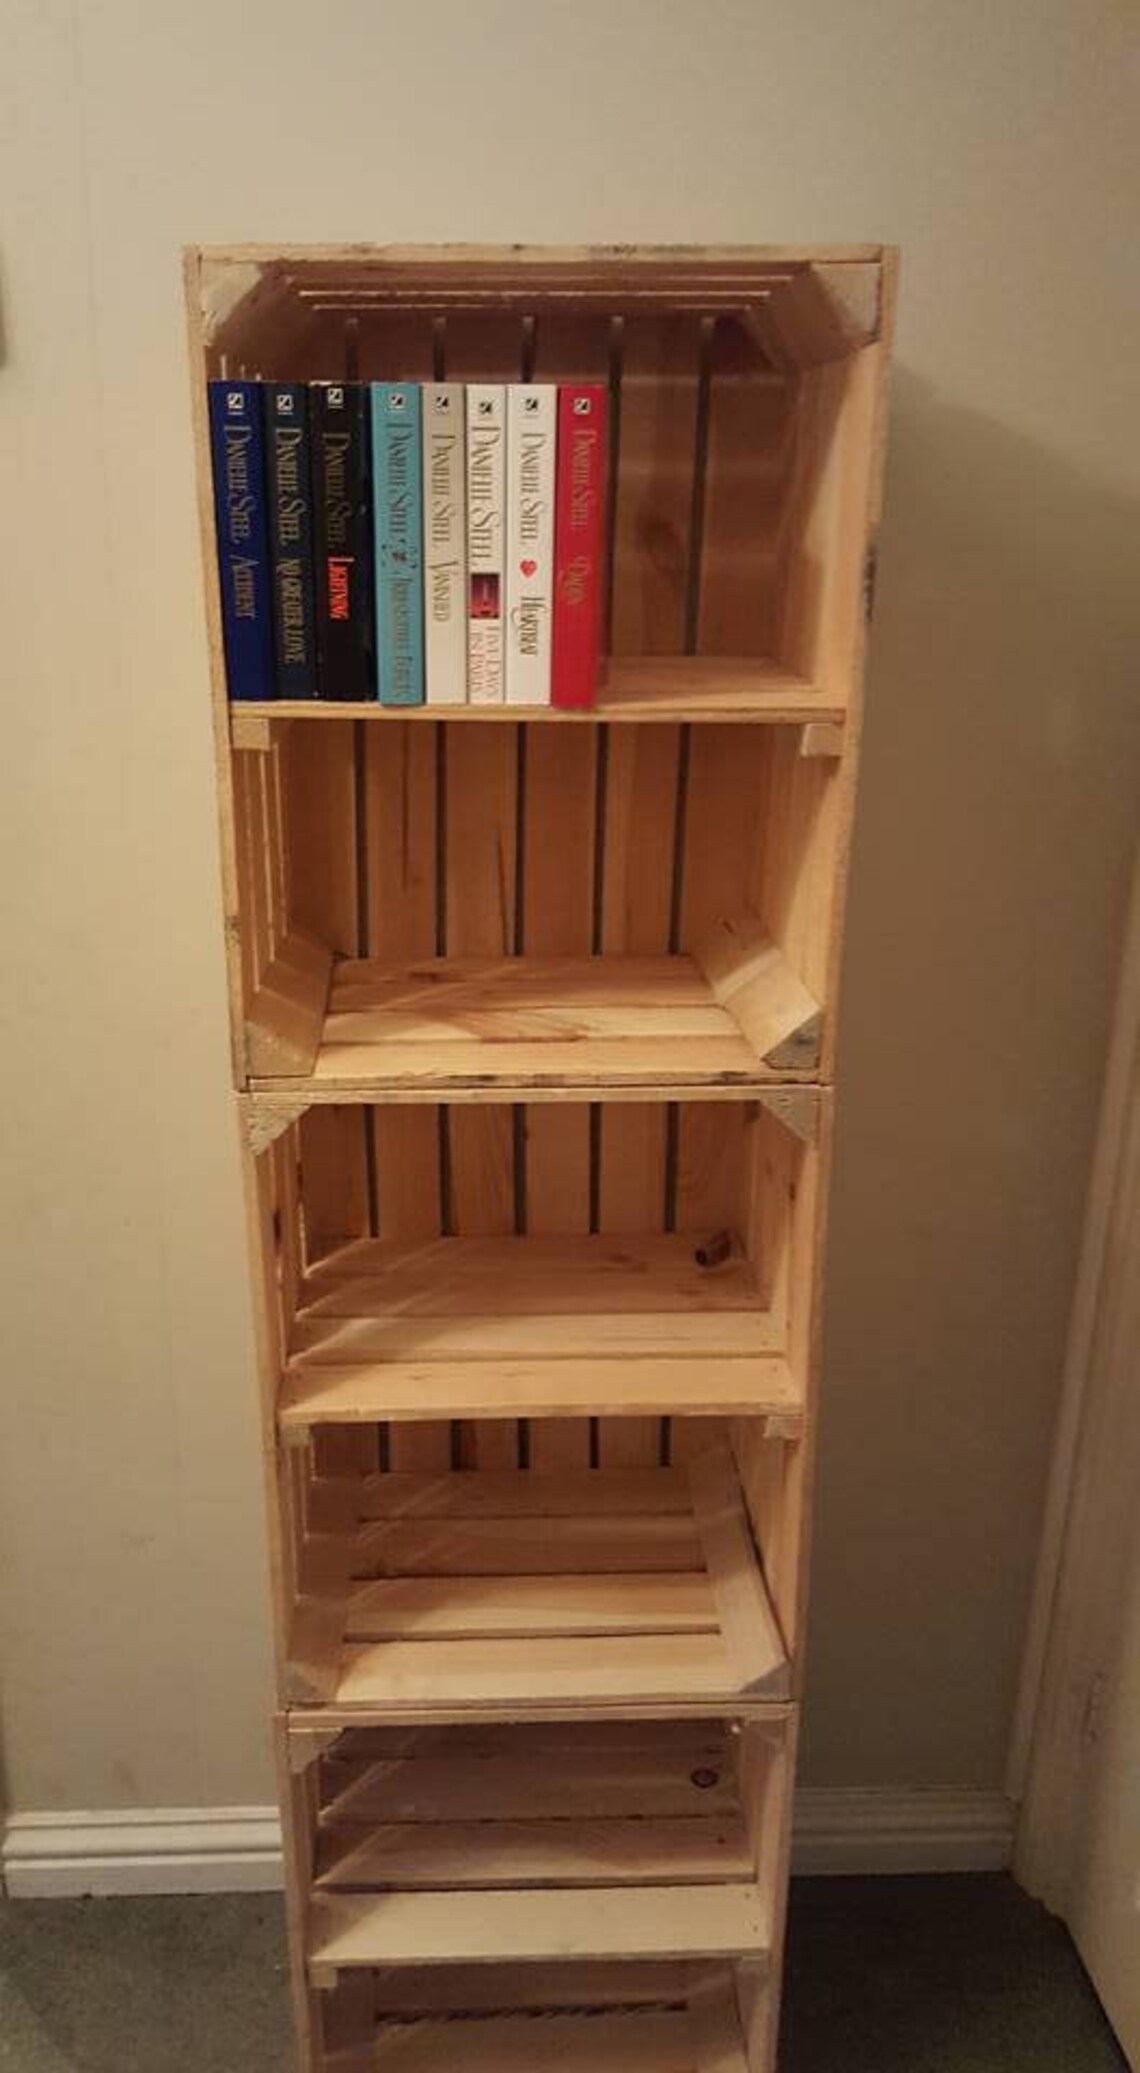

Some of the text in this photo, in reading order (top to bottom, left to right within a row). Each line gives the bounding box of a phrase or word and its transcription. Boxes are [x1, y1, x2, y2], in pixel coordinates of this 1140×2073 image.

[224, 425, 252, 493] DANIELLE
[276, 428, 302, 495] DANIELLE
[431, 434, 456, 496] DANIELLE
[520, 432, 547, 493] DANIELLE
[228, 496, 256, 544] STEEL
[278, 497, 307, 545] STEEL
[431, 500, 457, 546] STEEL
[470, 426, 501, 565] DANIELLE STEEL
[519, 498, 545, 545] STEEL
